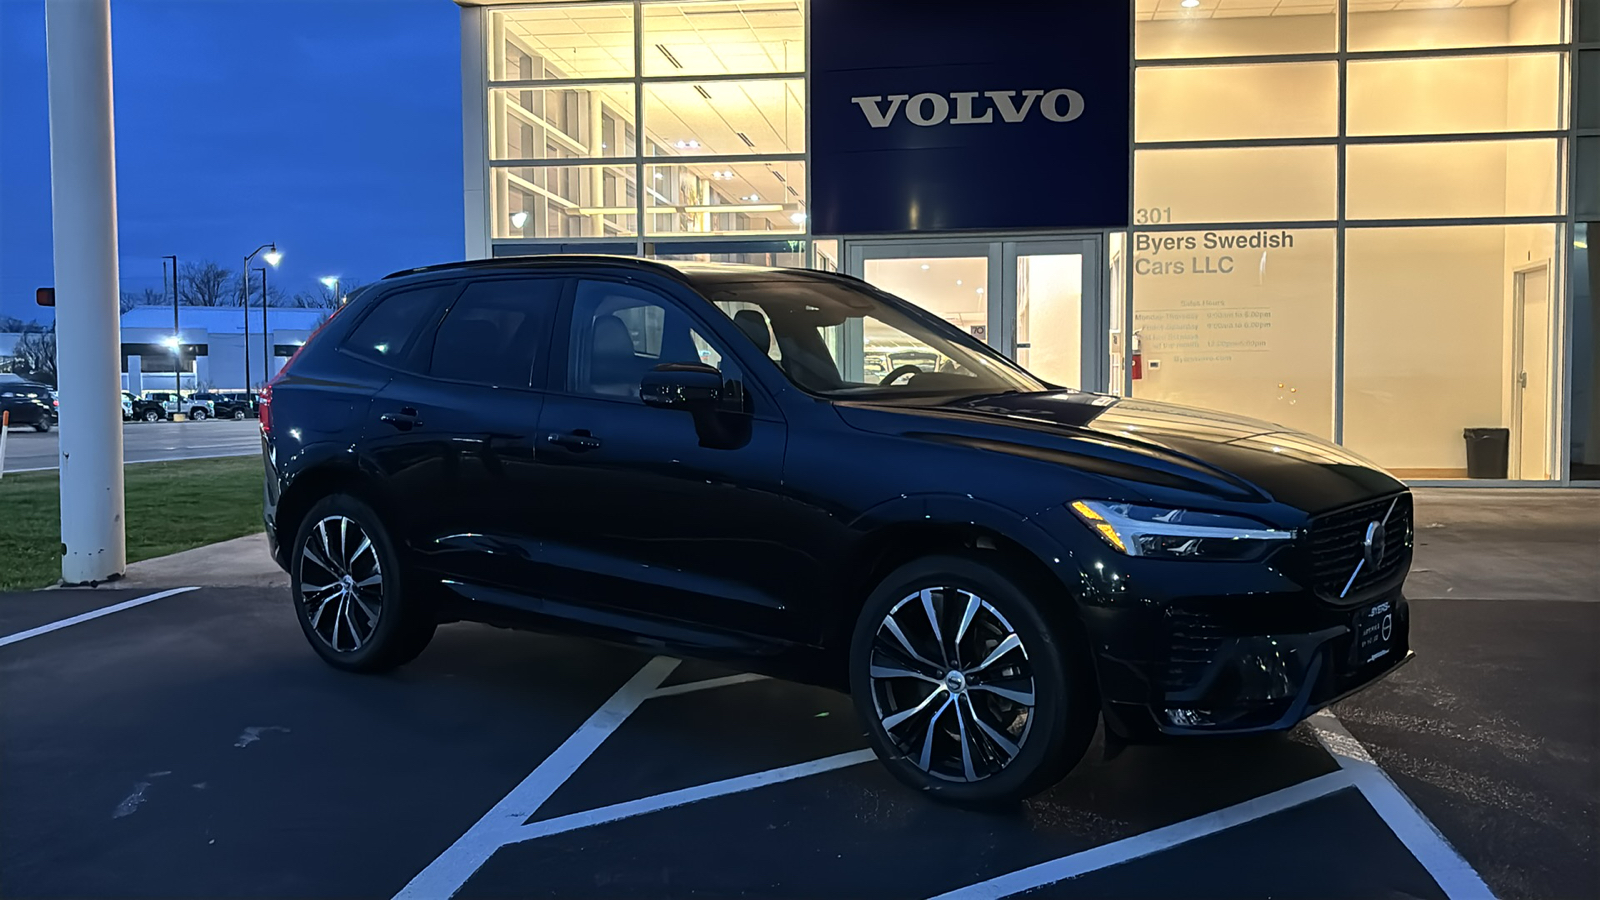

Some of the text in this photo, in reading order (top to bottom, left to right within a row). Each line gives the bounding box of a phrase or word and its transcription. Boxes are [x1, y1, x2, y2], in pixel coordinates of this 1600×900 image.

[851, 88, 1085, 128] VOLVO
[1136, 207, 1172, 224] 301
[1136, 231, 1294, 255] Byers Swedish
[1135, 256, 1234, 275] Cars LLC
